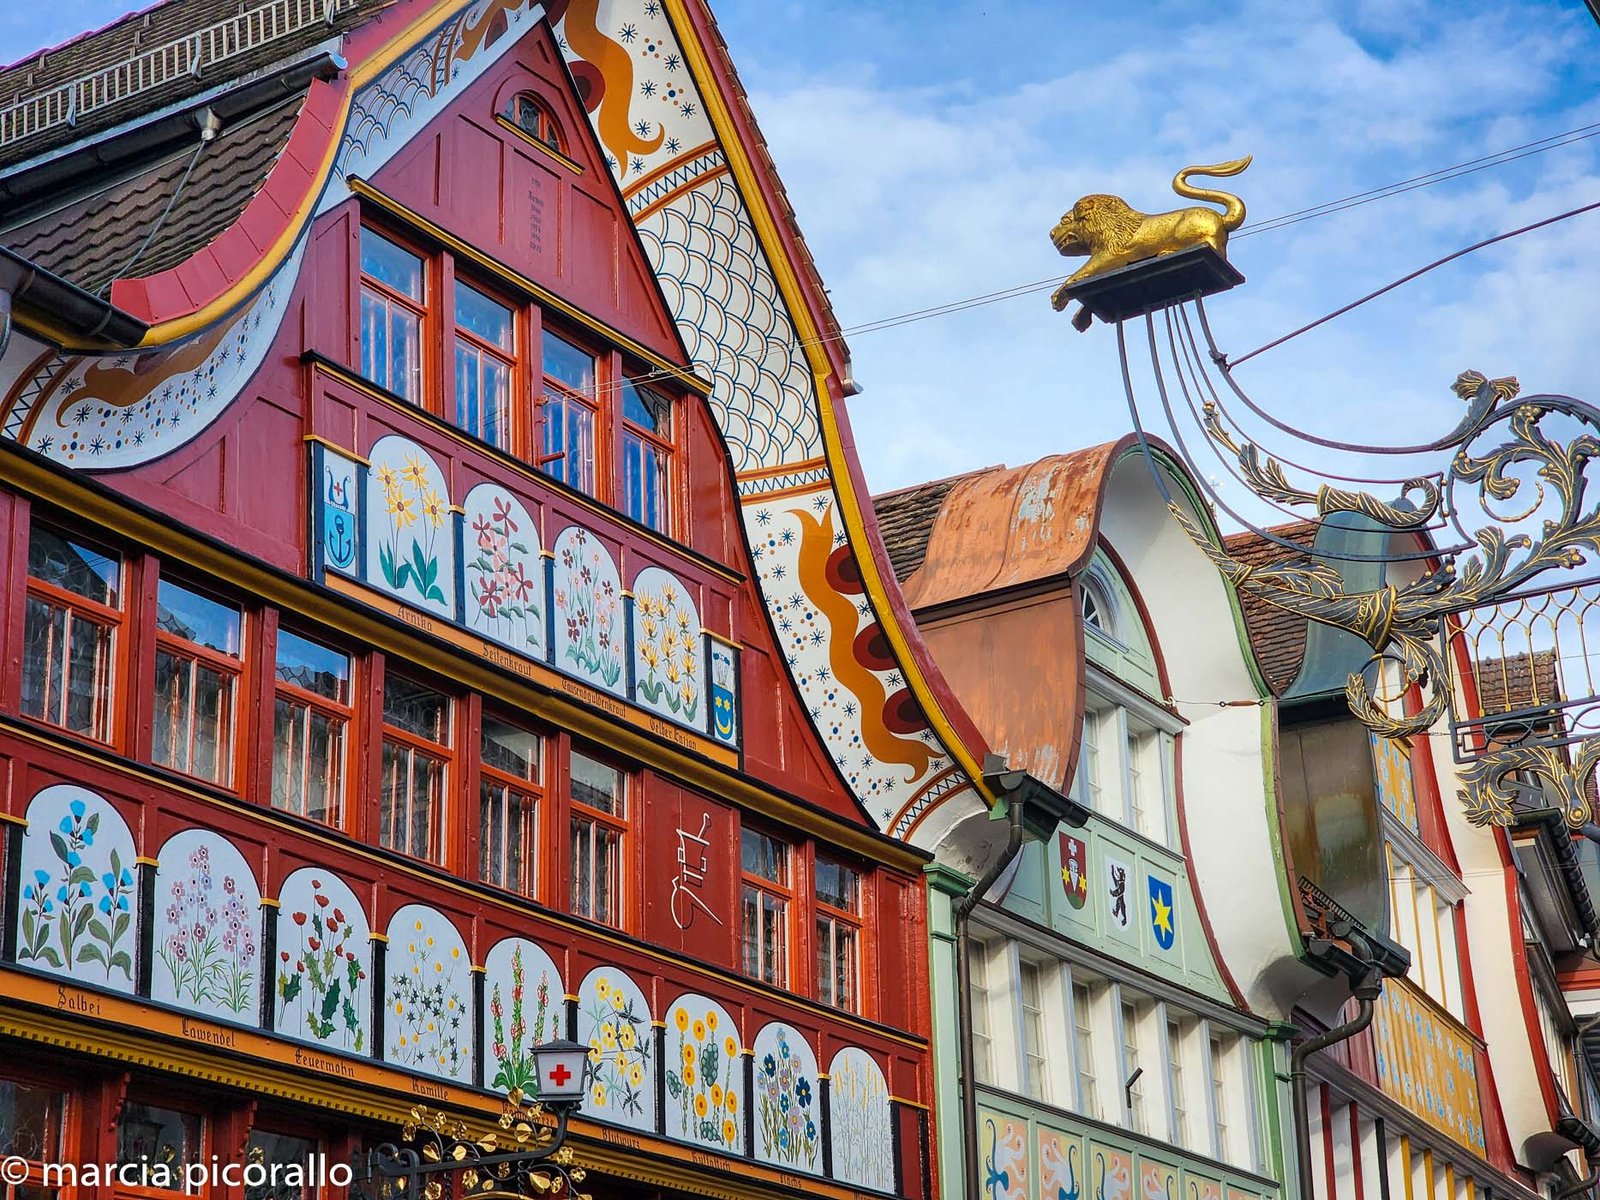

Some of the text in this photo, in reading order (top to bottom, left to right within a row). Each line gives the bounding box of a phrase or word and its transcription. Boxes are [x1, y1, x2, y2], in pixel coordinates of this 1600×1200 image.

[397, 606, 433, 632] Arnika
[649, 718, 672, 739] Gelber
[57, 984, 101, 1016] Salbei
[294, 1047, 355, 1078] Feuermohn
[412, 1077, 449, 1101] Kamille
